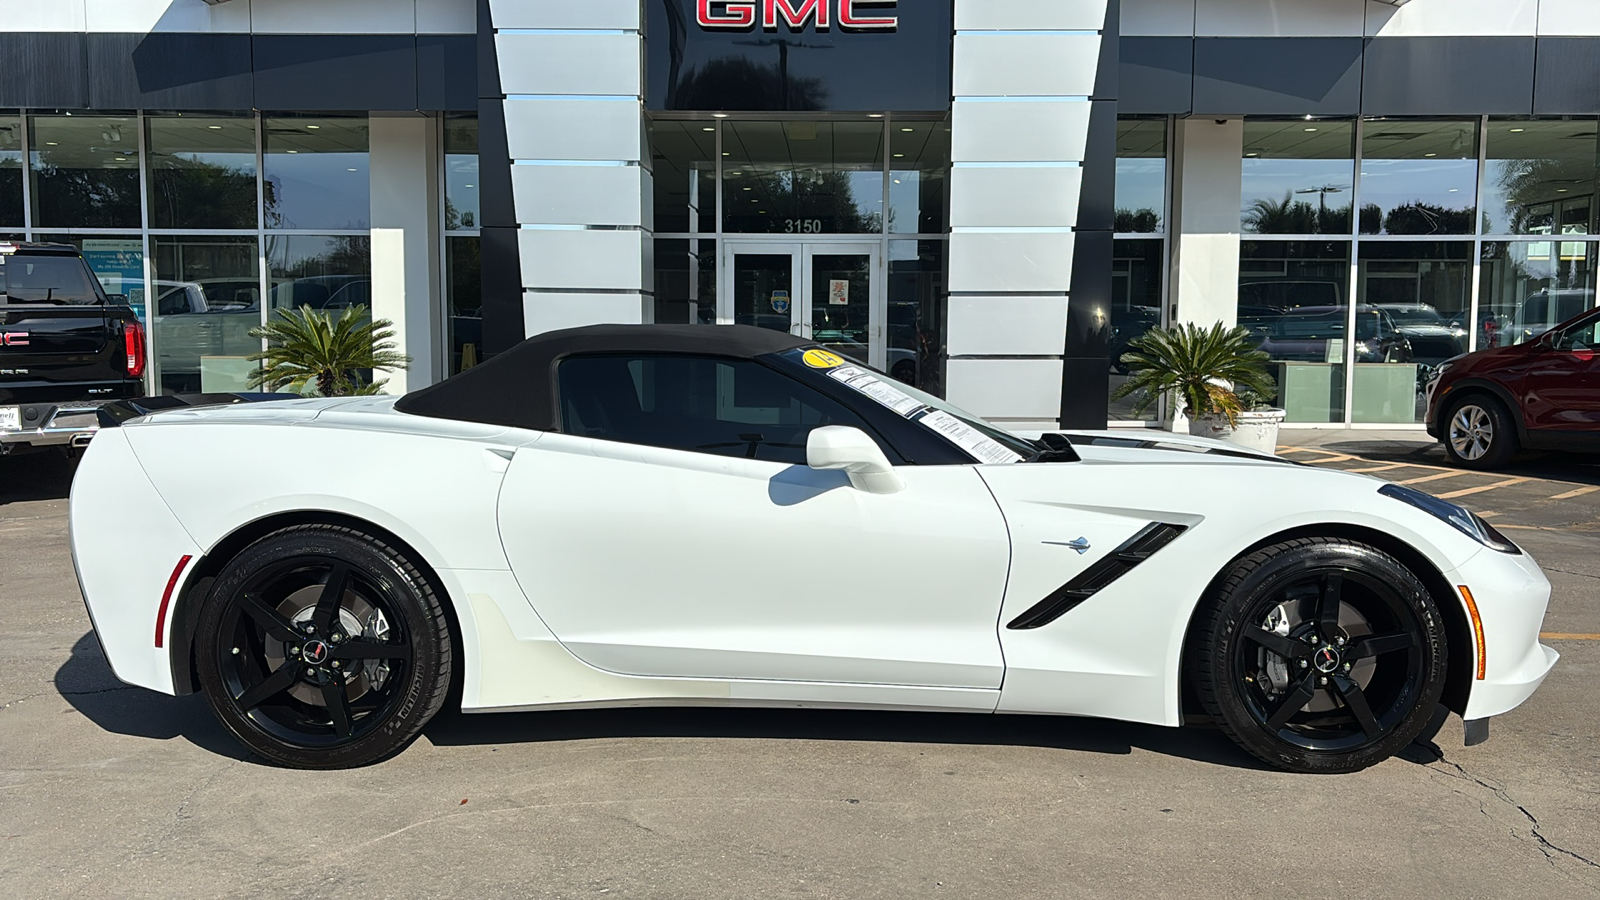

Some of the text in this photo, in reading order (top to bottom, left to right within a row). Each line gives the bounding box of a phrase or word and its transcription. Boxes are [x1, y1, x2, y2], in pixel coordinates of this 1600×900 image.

[696, 0, 899, 32] GMC
[784, 219, 822, 233] 3150
[1429, 625, 1440, 679] MICHELIN
[399, 663, 425, 719] MICHELIN
